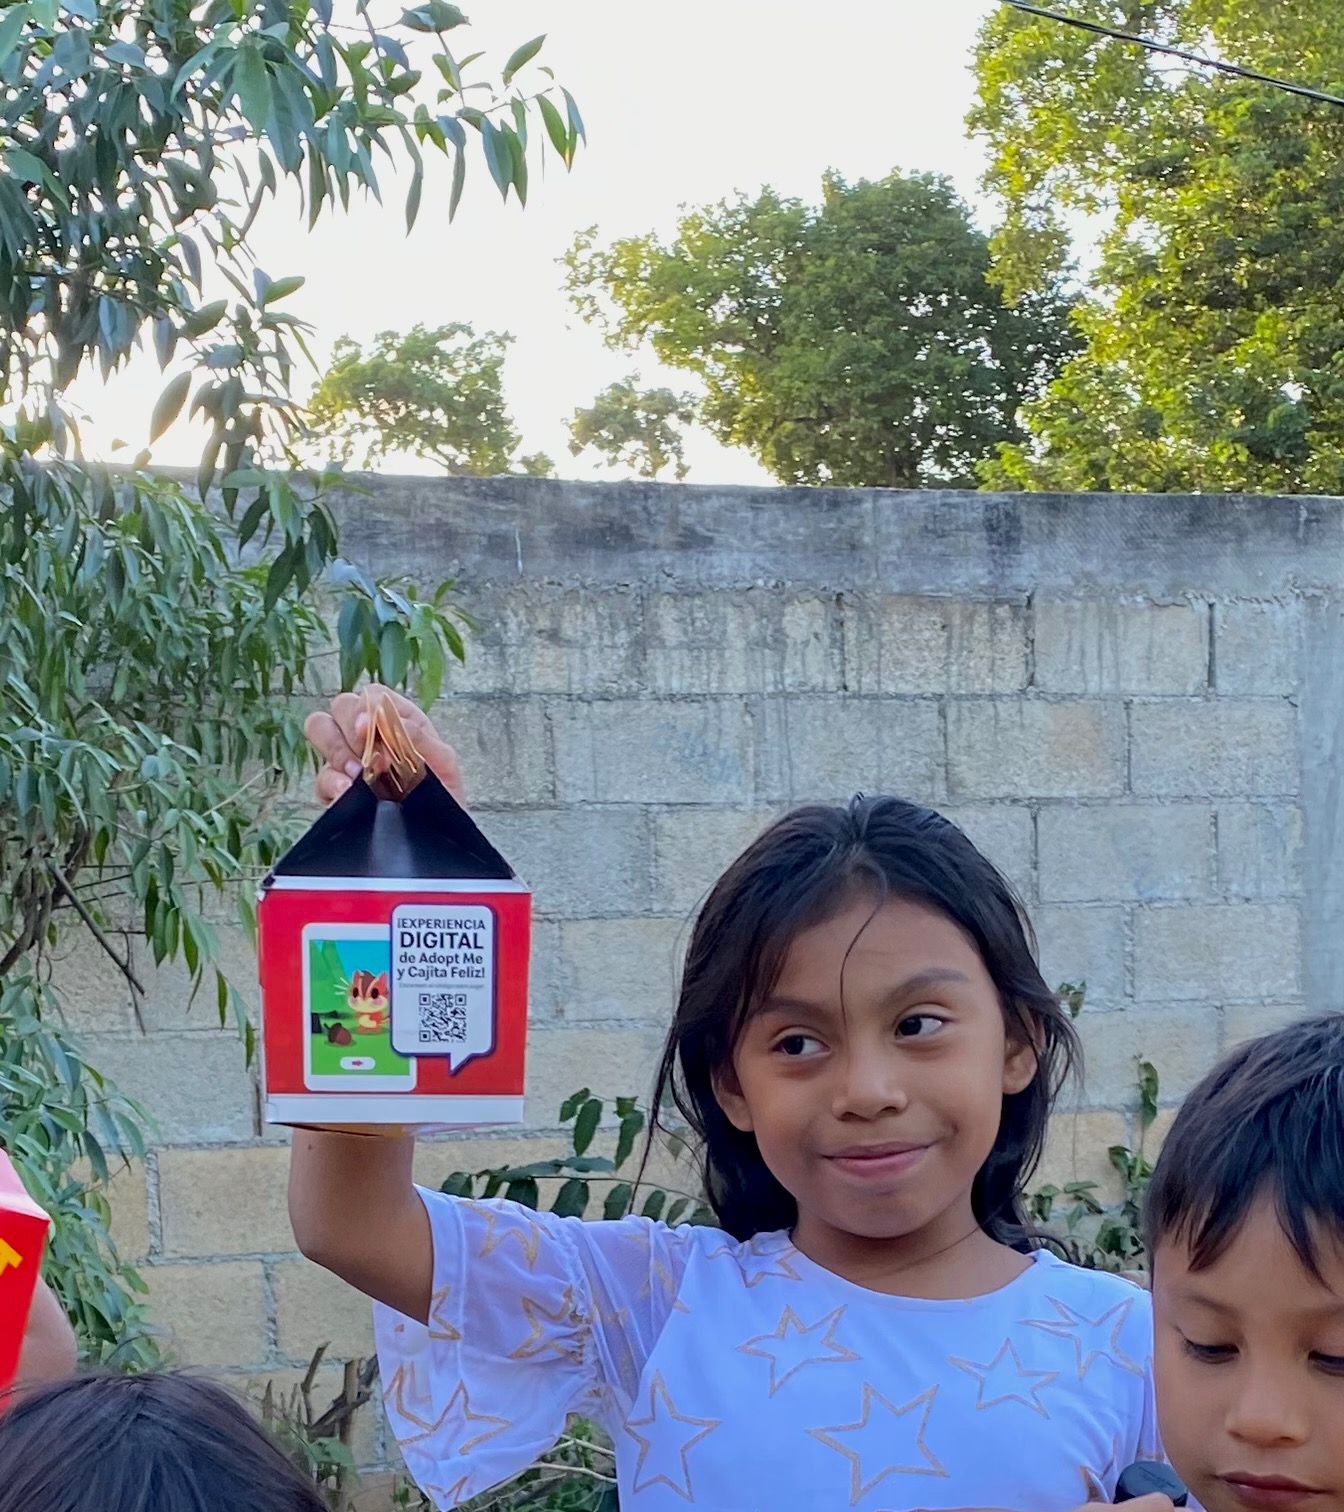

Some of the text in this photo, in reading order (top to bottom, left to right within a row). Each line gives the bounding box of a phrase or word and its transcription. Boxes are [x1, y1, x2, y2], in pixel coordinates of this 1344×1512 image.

[400, 931, 484, 950] DIGITAL
[399, 951, 484, 967] de Adopt Me
[397, 965, 485, 981] y Cajita Feliz!
